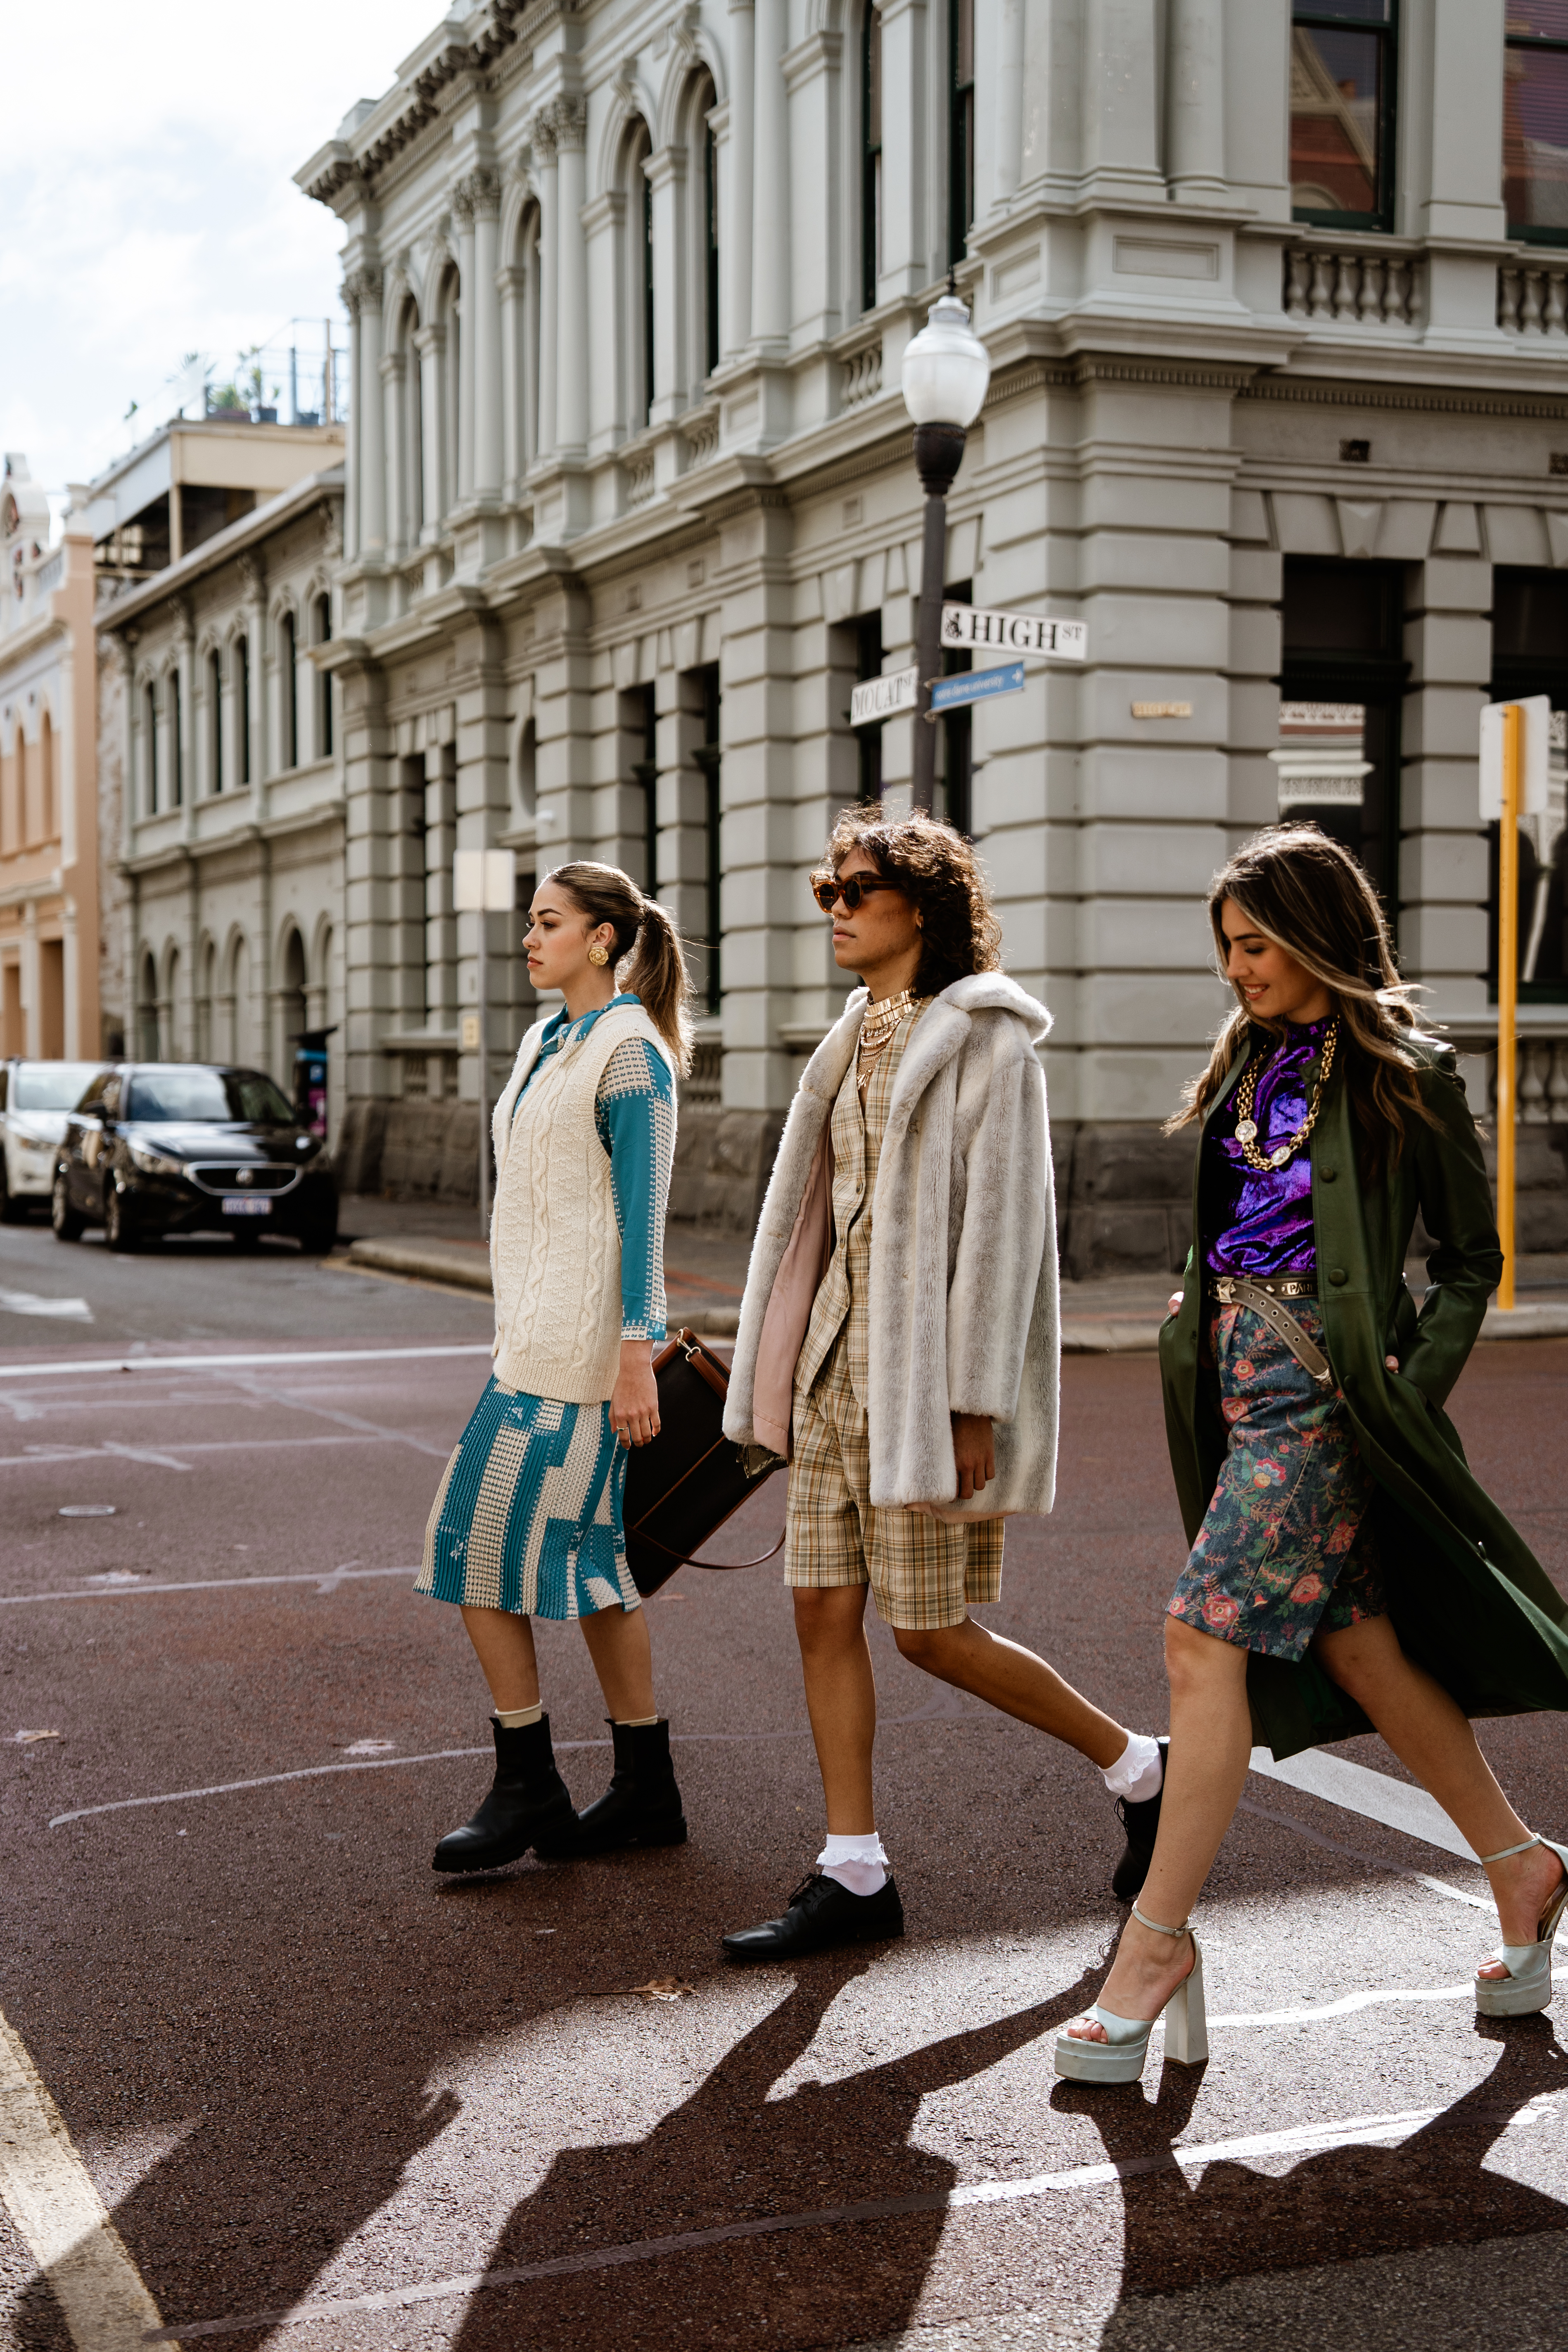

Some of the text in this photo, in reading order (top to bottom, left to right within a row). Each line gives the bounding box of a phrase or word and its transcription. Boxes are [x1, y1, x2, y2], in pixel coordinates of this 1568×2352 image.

[968, 613, 1082, 651] HIGH ST
[851, 676, 902, 718] MOUAT
[970, 674, 1004, 692] university
